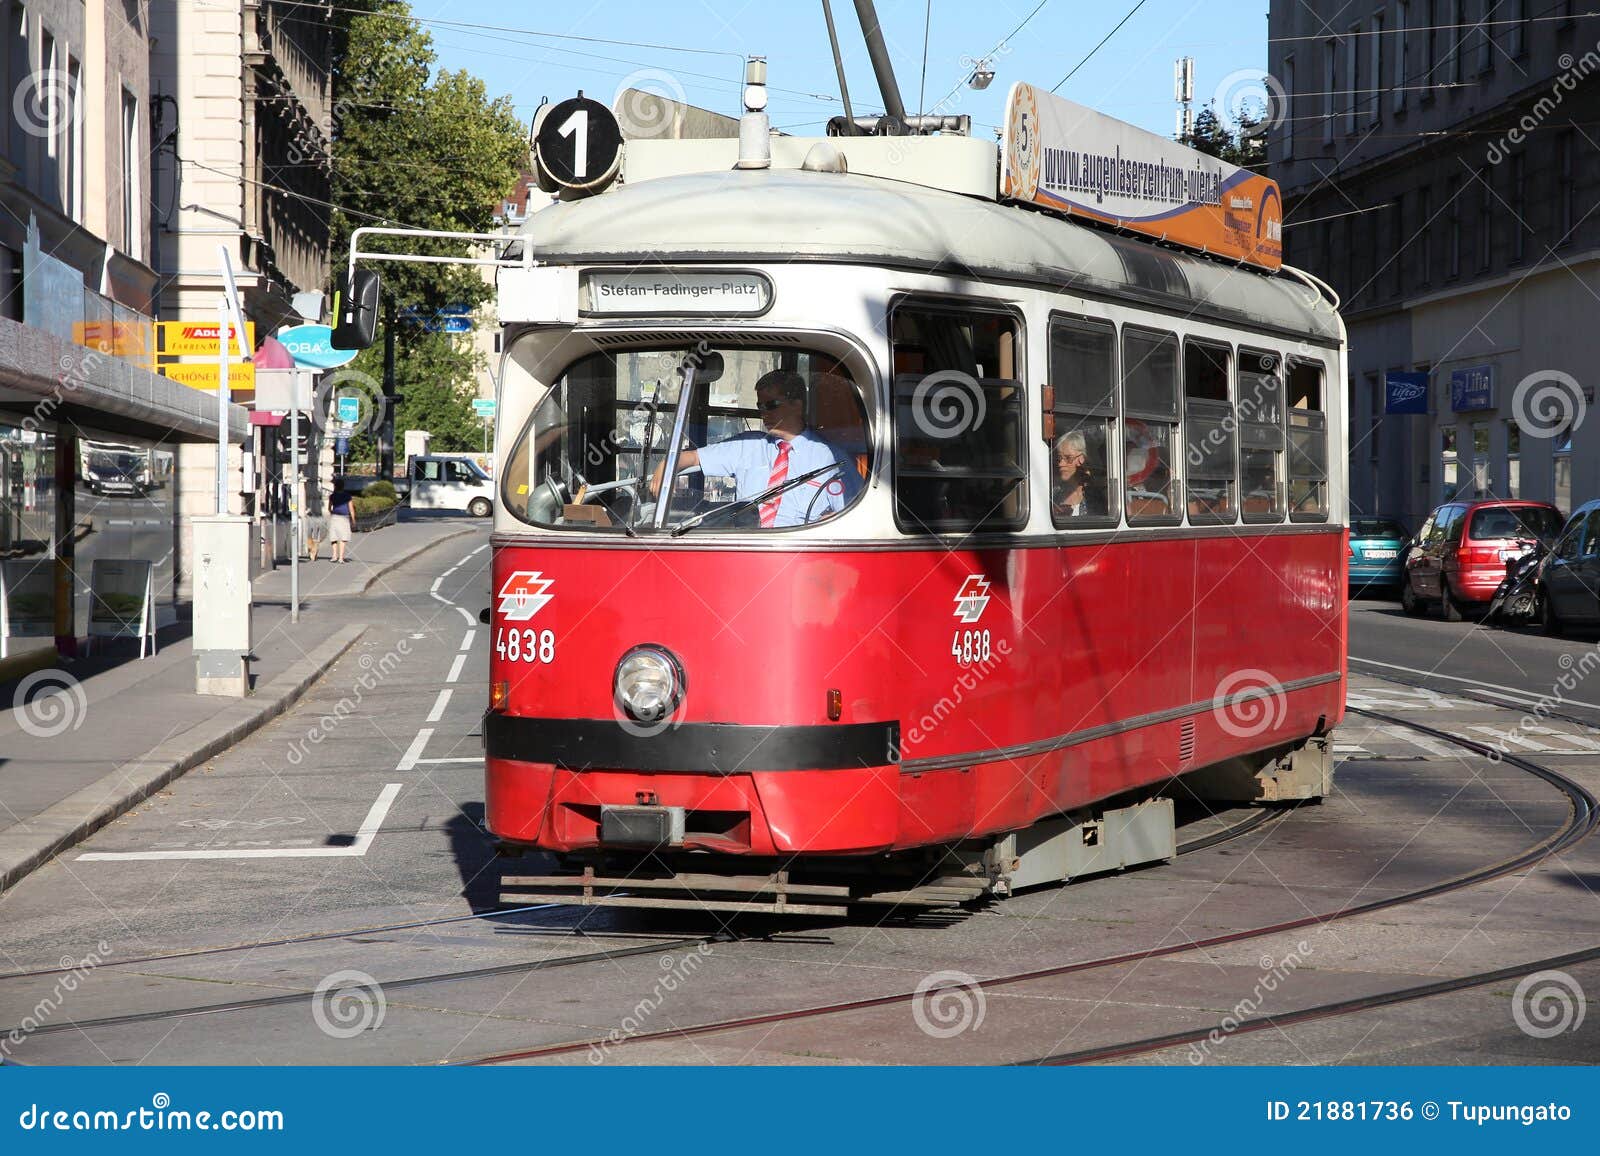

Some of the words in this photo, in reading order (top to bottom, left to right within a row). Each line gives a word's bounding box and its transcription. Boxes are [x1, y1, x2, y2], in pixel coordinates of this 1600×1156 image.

[558, 110, 588, 178] 1
[1044, 144, 1222, 206] www.augenlaserzentrum-wien.at
[601, 282, 756, 298] Stefan-Fadinger-Platz
[193, 329, 233, 337] ADLR
[283, 342, 321, 354] OBA
[213, 371, 250, 381] FRBEN
[496, 627, 556, 664] 4838
[951, 629, 991, 664] 4838
